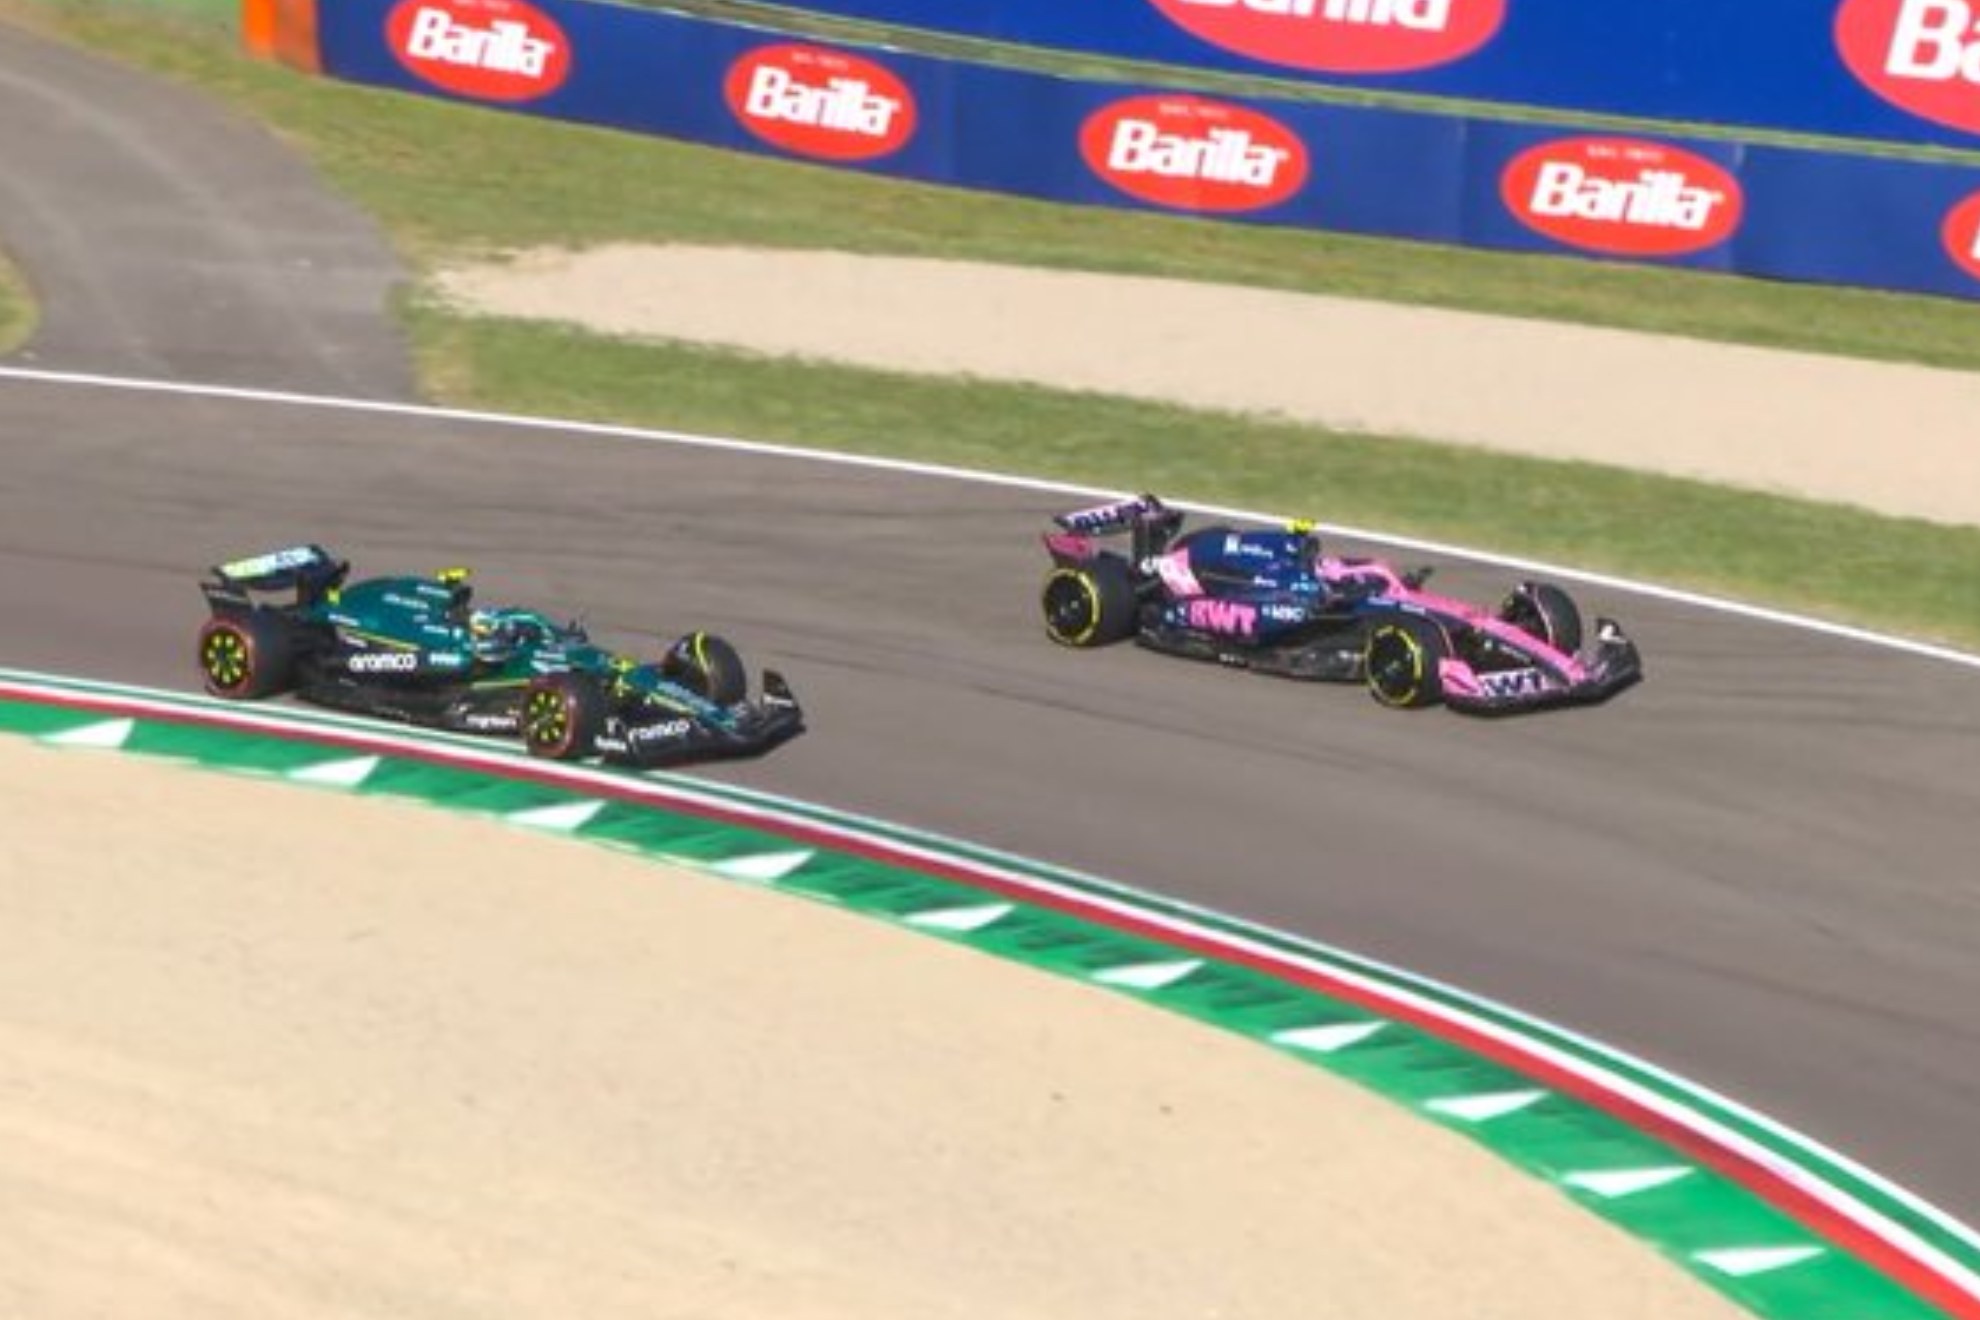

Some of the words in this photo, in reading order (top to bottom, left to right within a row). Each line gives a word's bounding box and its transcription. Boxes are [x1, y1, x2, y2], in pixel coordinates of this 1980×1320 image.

[406, 7, 554, 77] Barilla
[745, 66, 898, 136] Barilla
[1108, 118, 1288, 187] Barilla
[1530, 161, 1723, 230] Barilla
[349, 653, 417, 672] aramco
